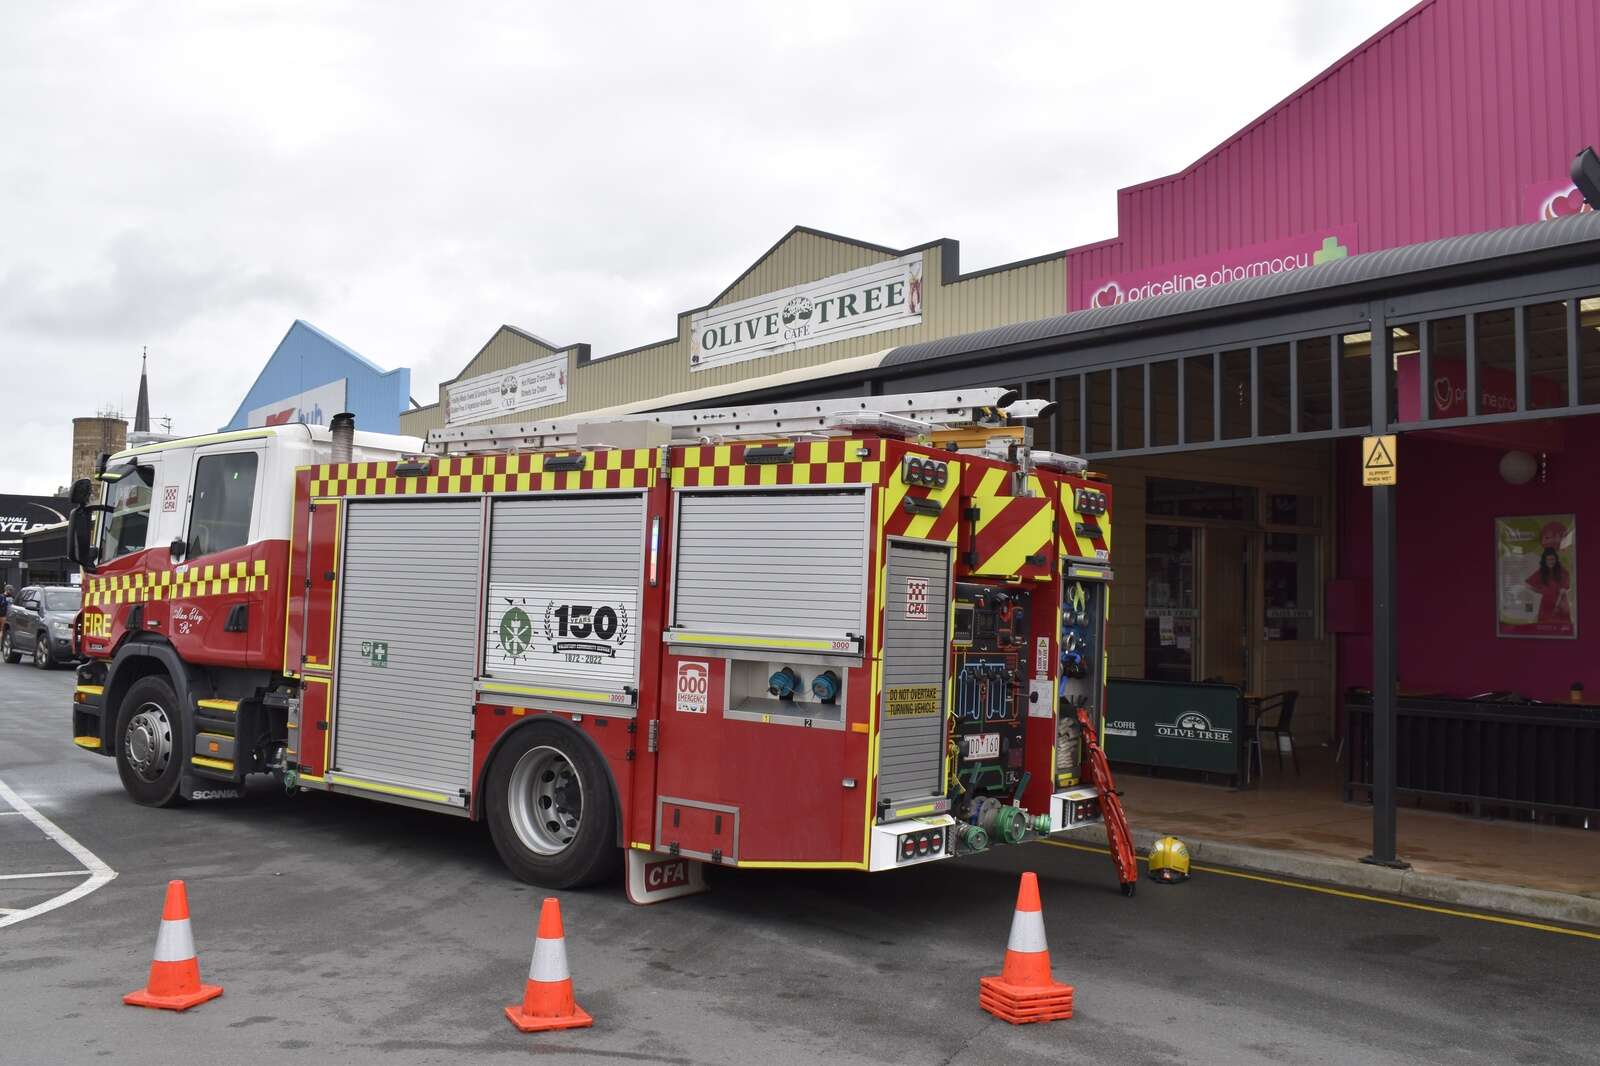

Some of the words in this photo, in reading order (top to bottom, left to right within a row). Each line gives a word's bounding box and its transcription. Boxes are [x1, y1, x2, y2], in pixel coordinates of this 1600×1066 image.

[1128, 274, 1207, 302] priceline
[702, 312, 780, 350] OLIVE
[814, 280, 906, 325] TREE
[908, 602, 925, 615] CFA
[83, 613, 112, 638] FIRE
[555, 604, 618, 640] 150
[832, 641, 850, 649] 3000
[585, 655, 602, 664] 2022
[679, 676, 707, 694] 000
[677, 692, 707, 705] EMERGENCY
[889, 689, 897, 700] DO
[899, 689, 910, 700] NOT
[910, 687, 937, 700] OVERTAKE
[890, 703, 914, 716] TURNING
[914, 701, 936, 714] VEHICLE
[1113, 720, 1136, 729] COFFEE
[1158, 727, 1195, 738] OLIVE
[1197, 730, 1230, 741] TREE
[192, 789, 240, 800] SCANIA
[648, 862, 685, 886] CFA
